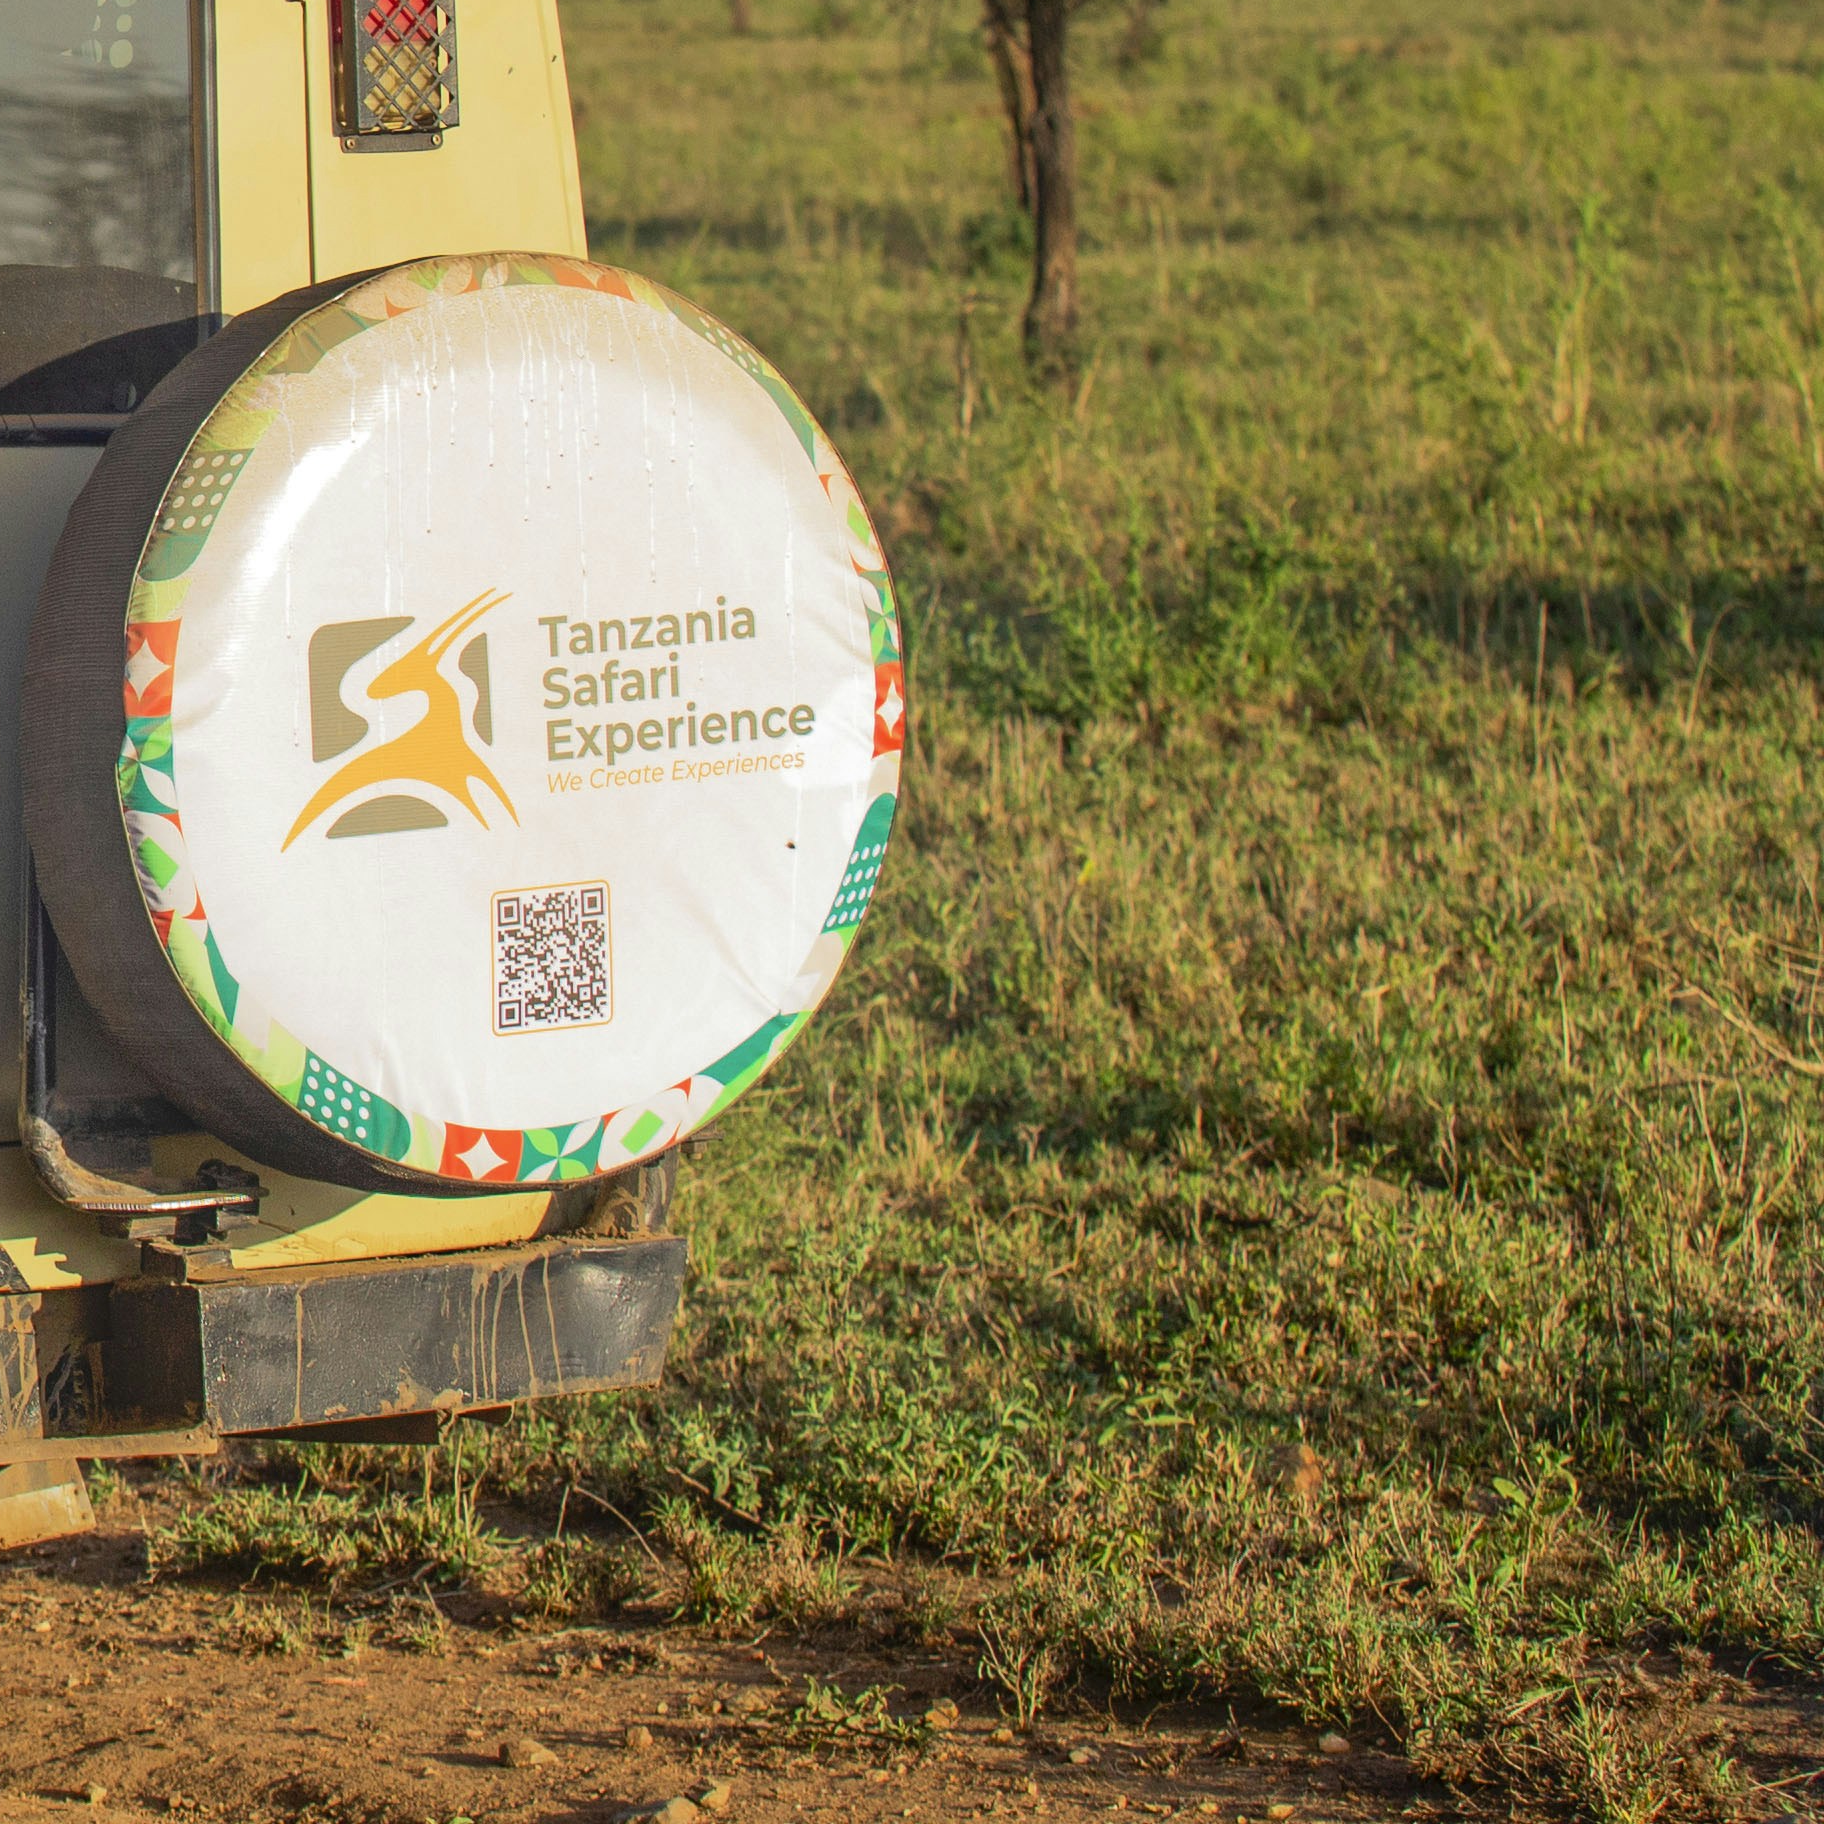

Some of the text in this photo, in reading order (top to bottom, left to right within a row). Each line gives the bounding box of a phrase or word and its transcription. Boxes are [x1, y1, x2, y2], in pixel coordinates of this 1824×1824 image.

[538, 595, 757, 657] Tanzania
[542, 651, 680, 710] Safari
[546, 701, 816, 766] Experience
[547, 751, 806, 794] We Create Experiences
